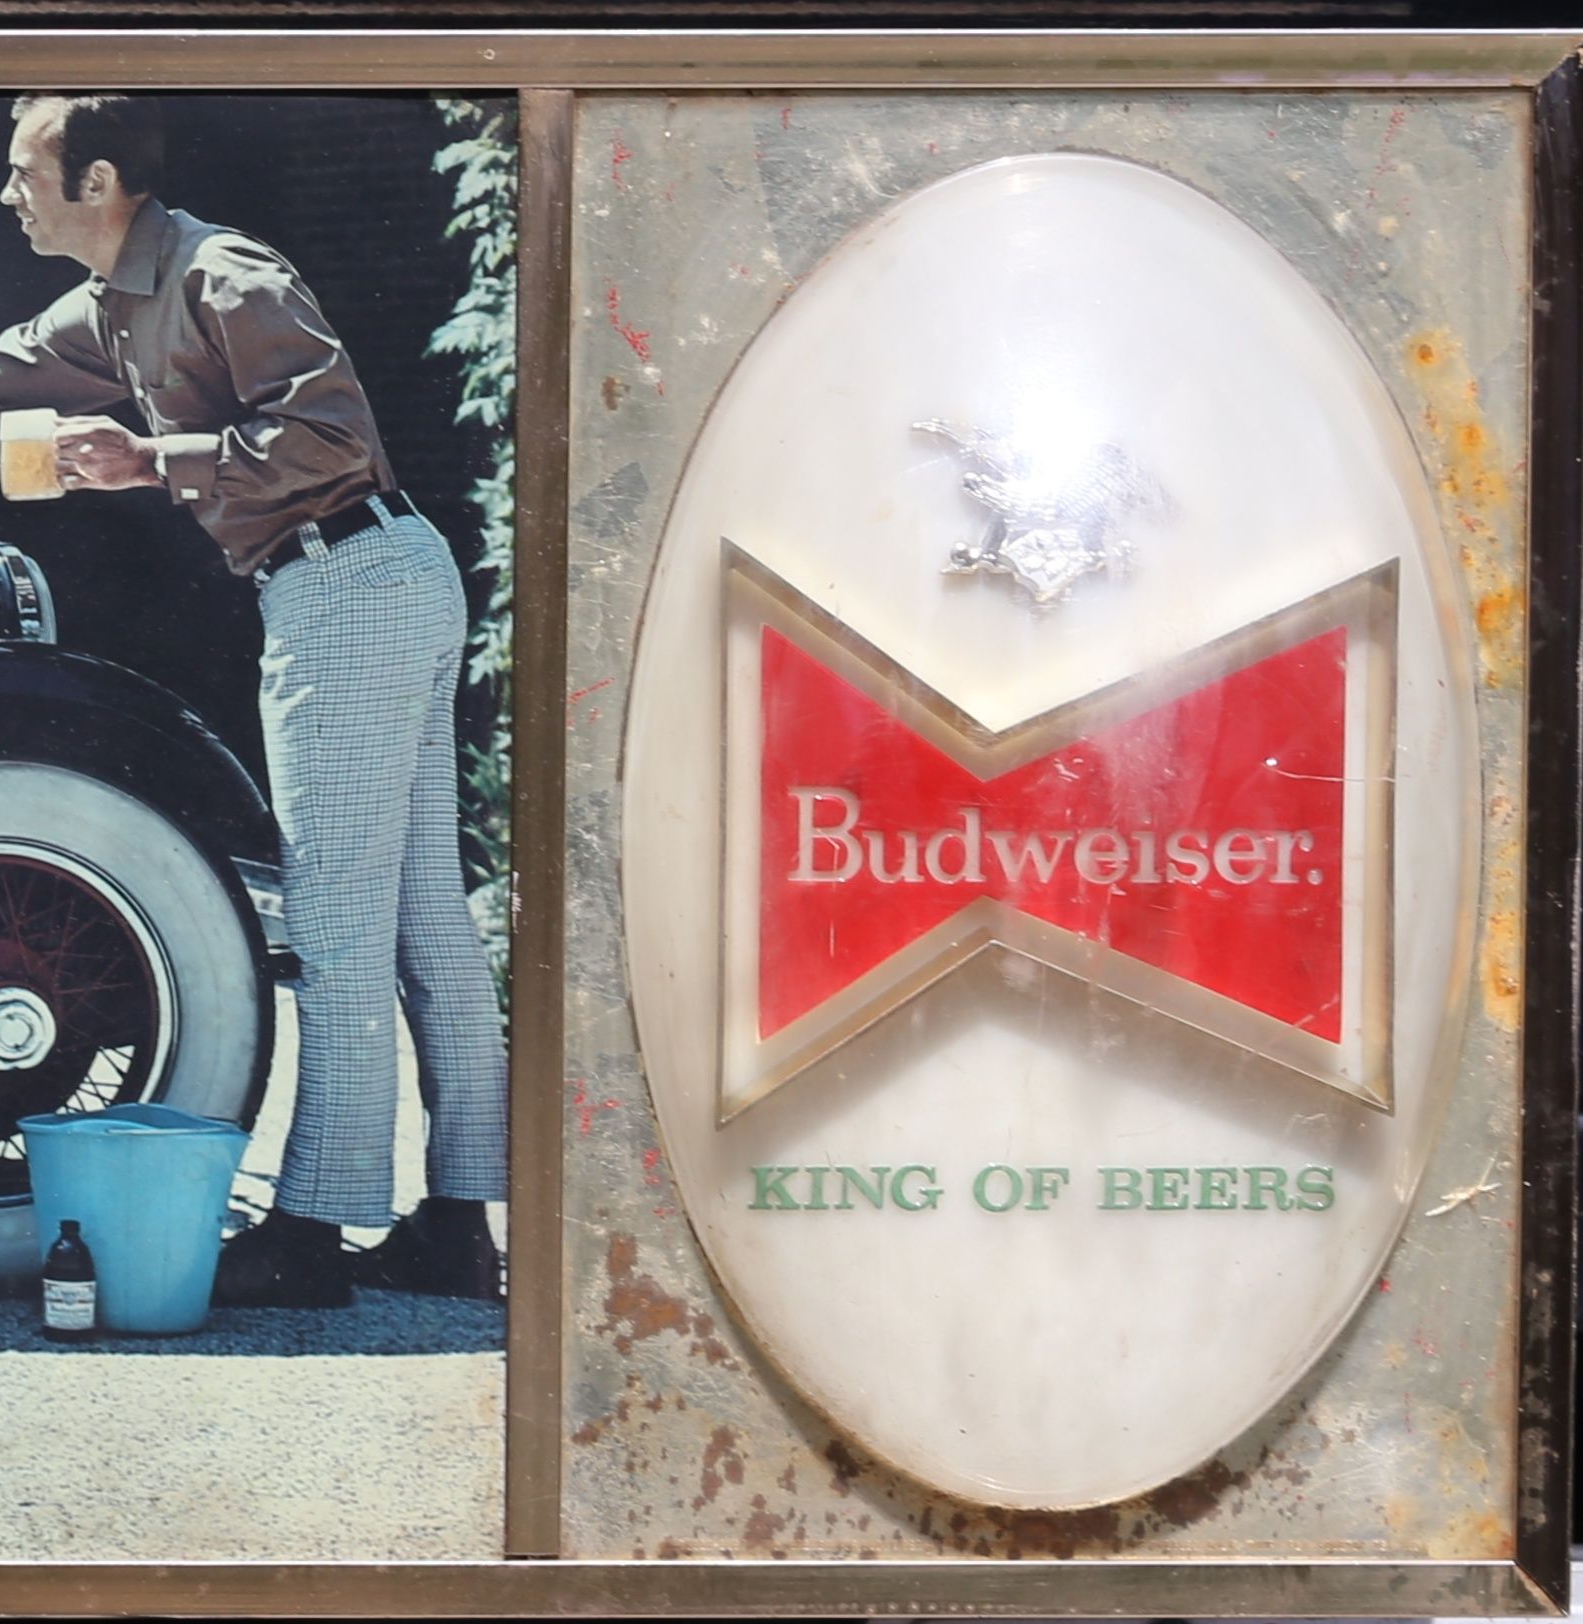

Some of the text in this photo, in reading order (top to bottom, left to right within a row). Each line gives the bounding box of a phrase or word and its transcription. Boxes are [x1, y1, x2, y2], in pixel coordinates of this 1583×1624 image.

[747, 1164, 1336, 1212] KING OF BEERS
